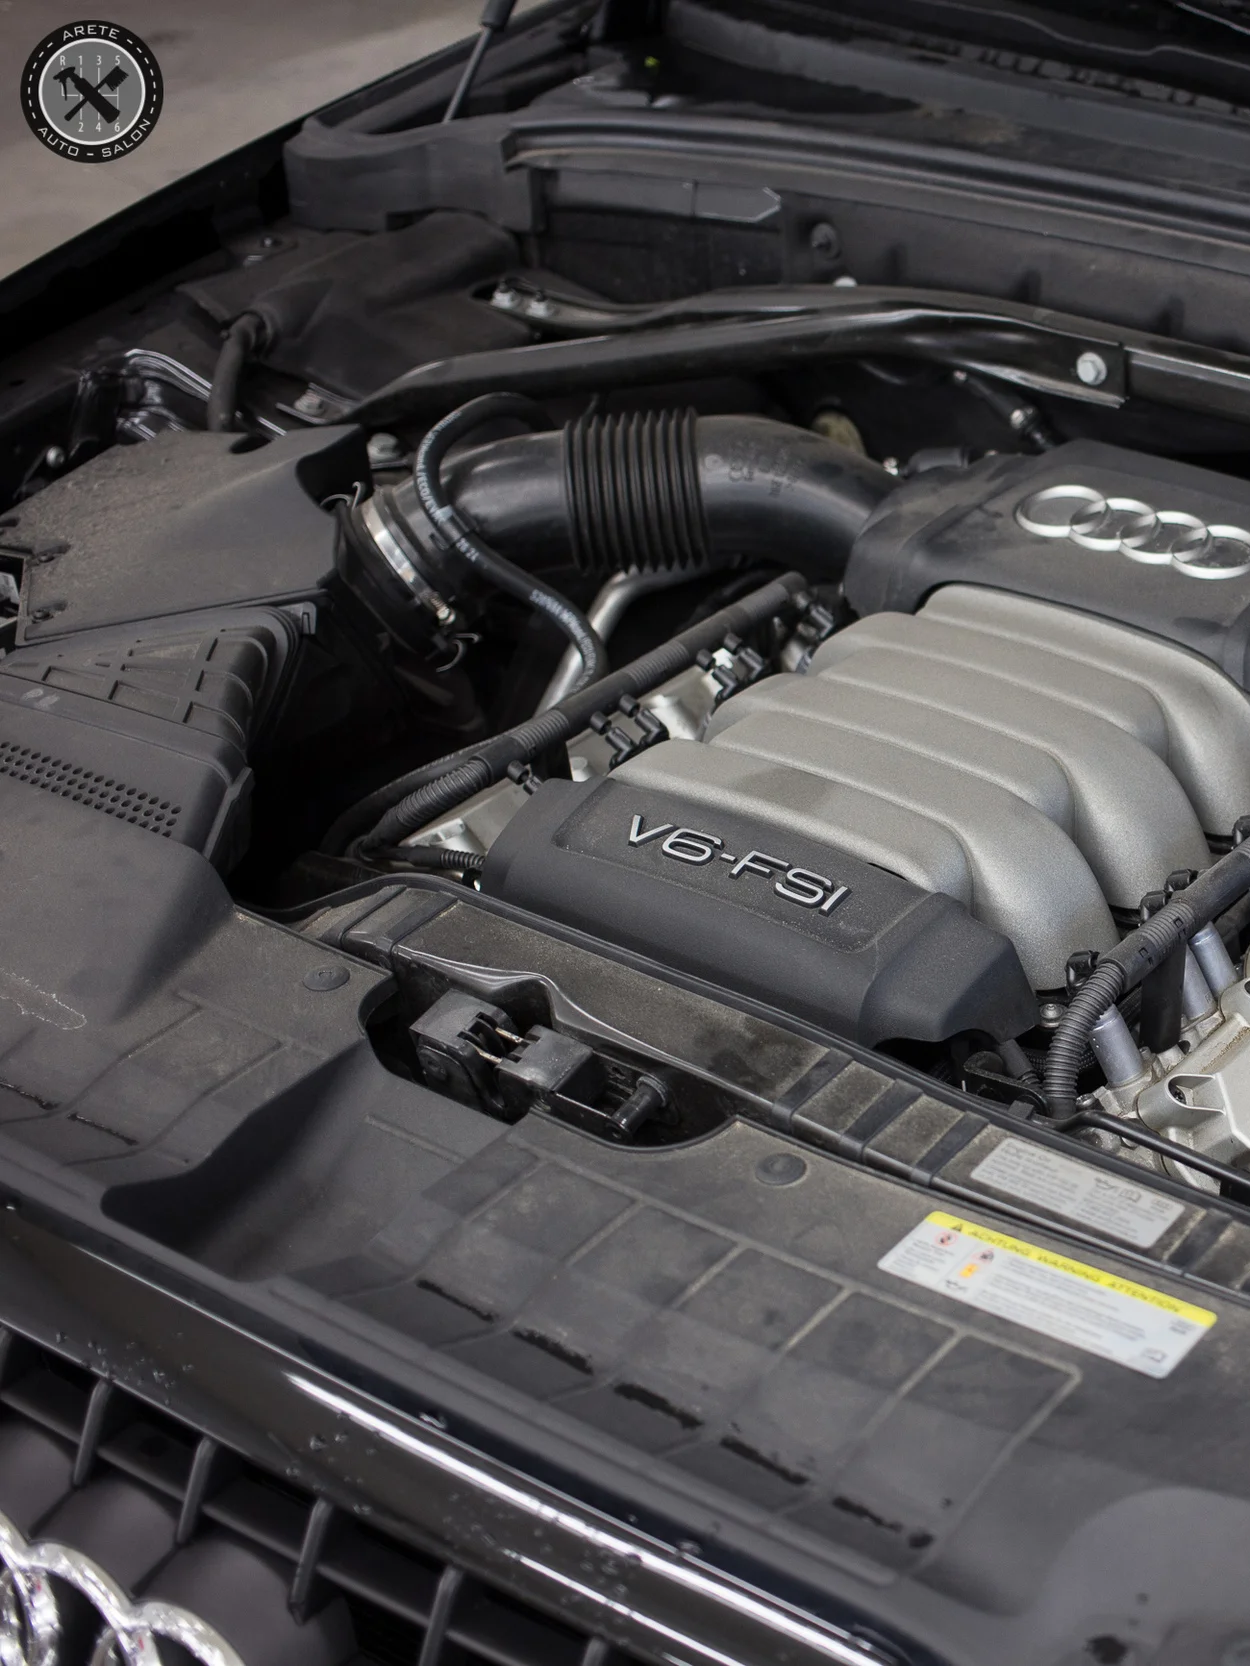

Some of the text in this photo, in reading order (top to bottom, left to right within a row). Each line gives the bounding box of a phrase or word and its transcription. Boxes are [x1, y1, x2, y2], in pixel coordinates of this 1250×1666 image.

[628, 814, 851, 917] V6-FSI
[968, 1230, 1031, 1257] ACHTUNG
[1037, 1254, 1101, 1283] WARNING
[1108, 1280, 1182, 1313] ATTENTION
